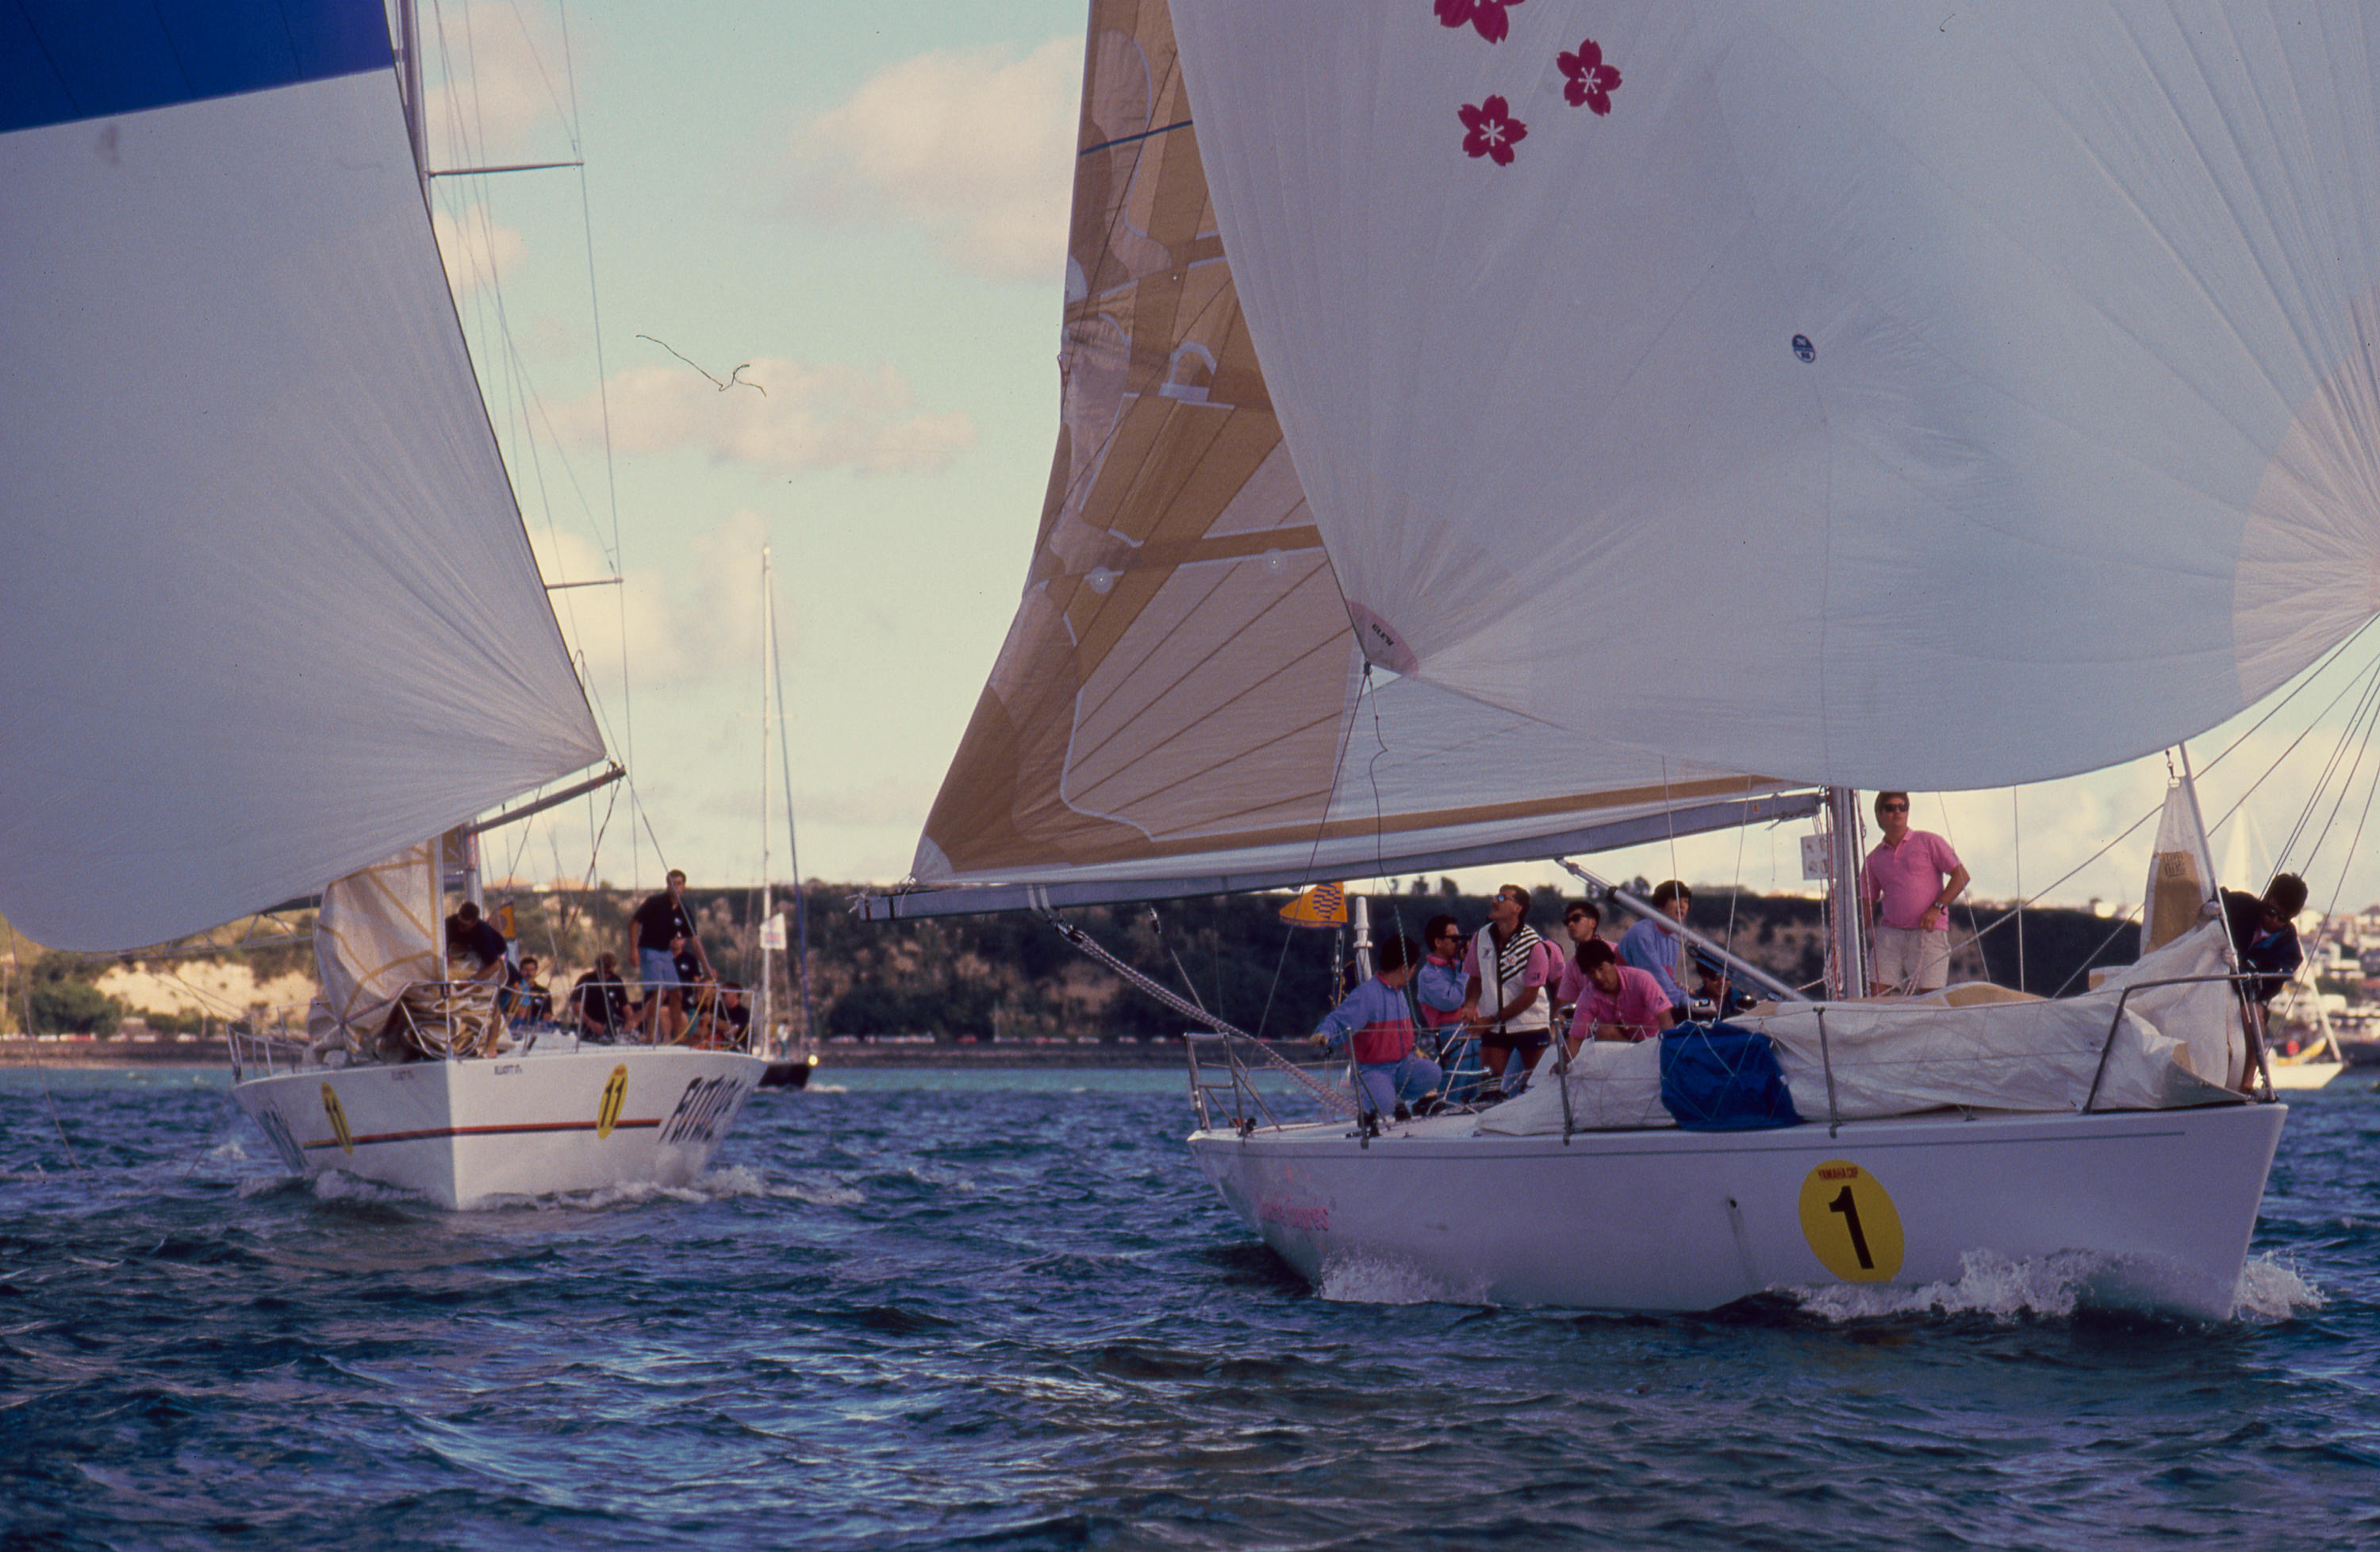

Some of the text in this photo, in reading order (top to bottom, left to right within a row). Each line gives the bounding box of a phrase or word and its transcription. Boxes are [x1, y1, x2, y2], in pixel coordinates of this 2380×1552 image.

[601, 1078, 624, 1128] 11
[1817, 1167, 1846, 1181] YAMAHA
[1829, 1185, 1875, 1270] 1
